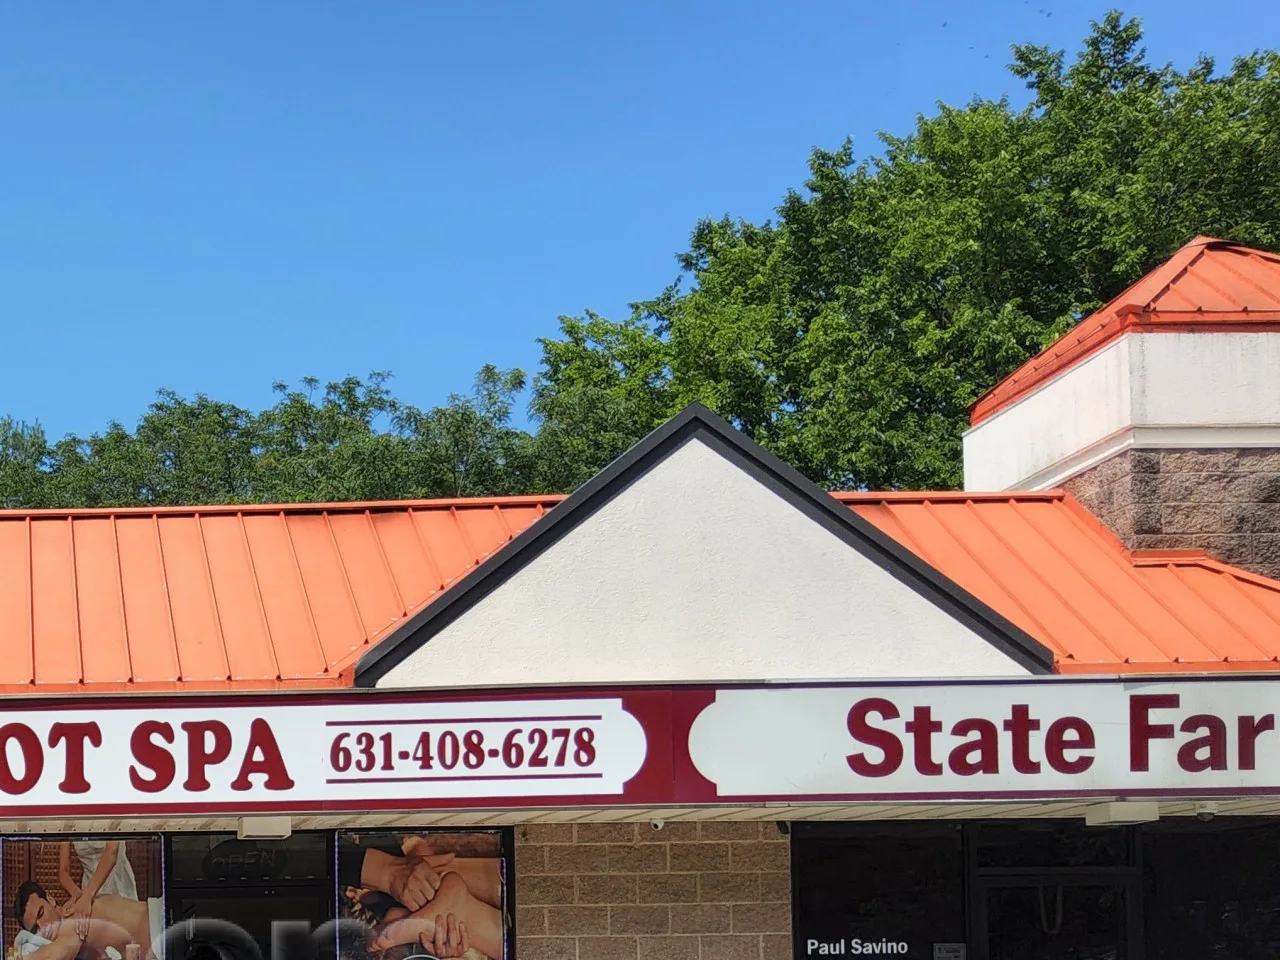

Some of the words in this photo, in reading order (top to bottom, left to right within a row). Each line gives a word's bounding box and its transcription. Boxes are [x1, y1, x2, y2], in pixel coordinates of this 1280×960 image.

[128, 717, 295, 793] SPA
[329, 726, 597, 773] 631-408-6278
[845, 697, 1096, 777] State
[1129, 693, 1275, 773] Far
[807, 938, 846, 955] Paul
[851, 937, 909, 955] Savino
